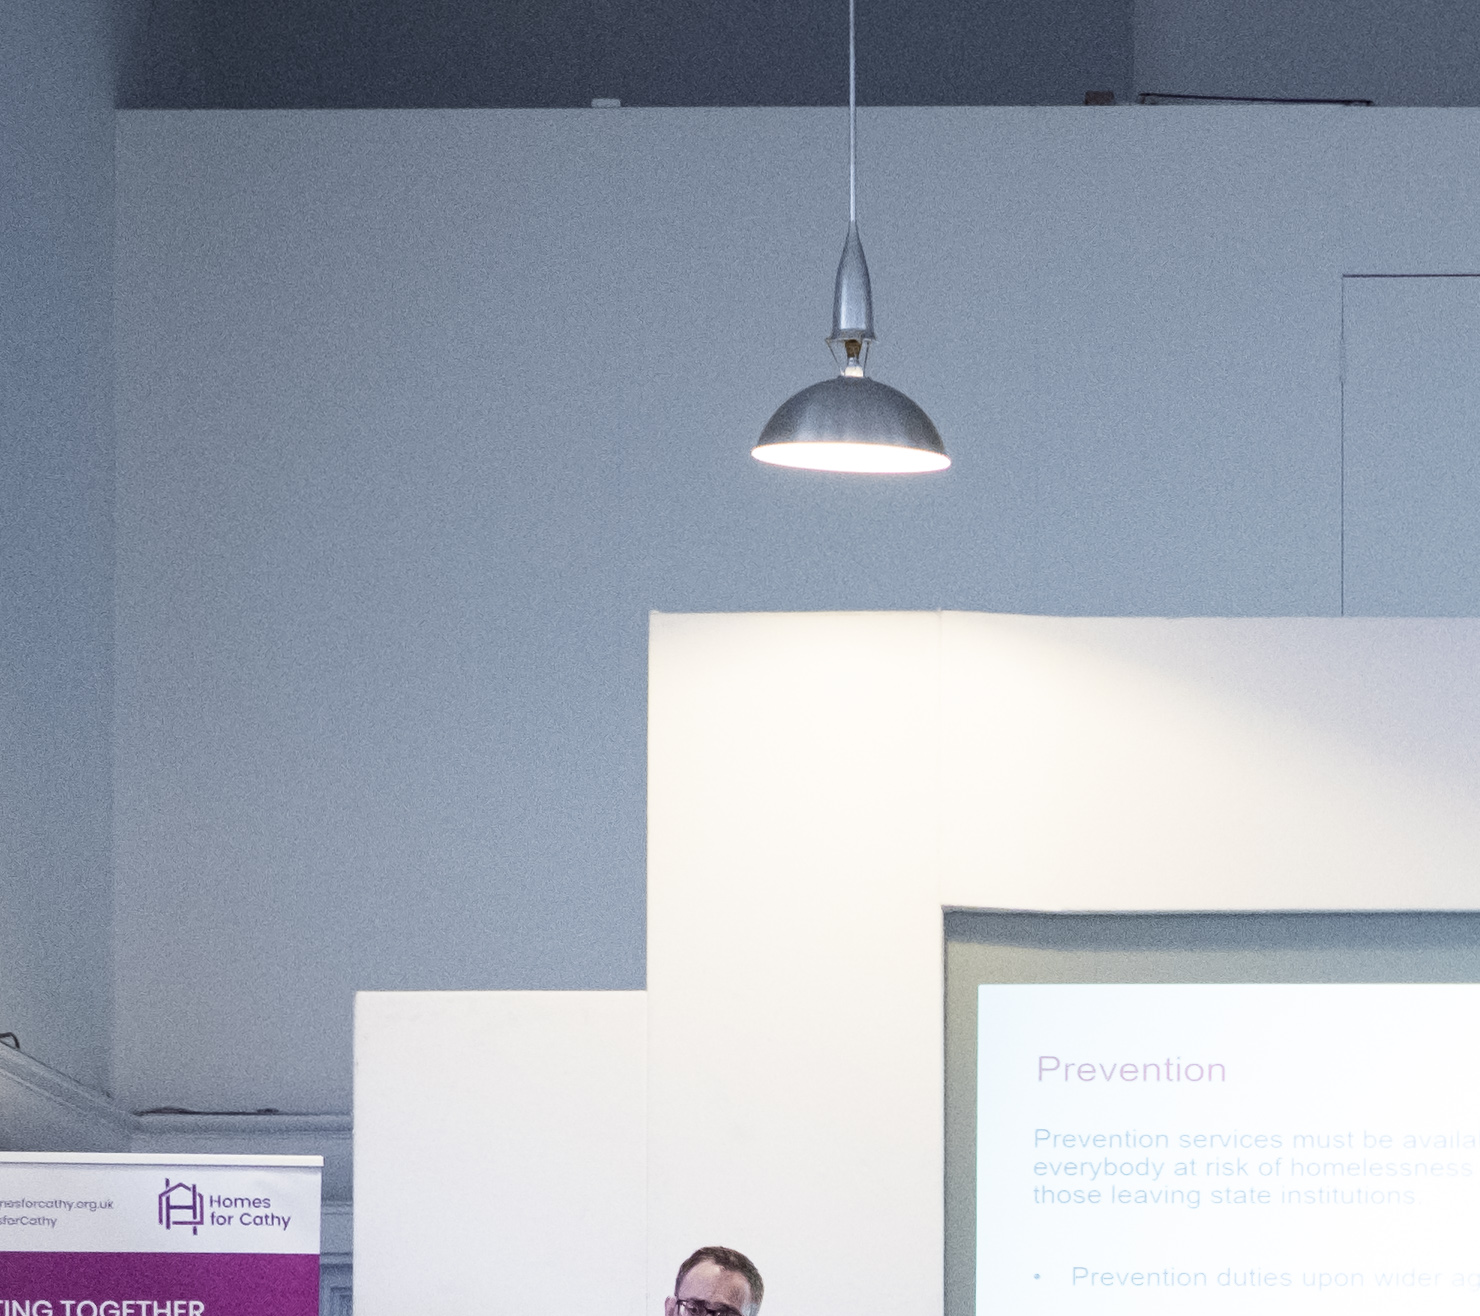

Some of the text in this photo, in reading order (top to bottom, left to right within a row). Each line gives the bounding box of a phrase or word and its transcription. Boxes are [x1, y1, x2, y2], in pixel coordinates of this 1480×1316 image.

[1037, 1056, 1227, 1083] Prevention
[1033, 1128, 1169, 1149] Prevention
[1178, 1130, 1284, 1149] services
[1292, 1132, 1354, 1149] must
[1363, 1130, 1394, 1149] be
[1032, 1157, 1165, 1182] everybody
[1173, 1159, 1197, 1177] at
[1206, 1158, 1249, 1177] risk
[1257, 1157, 1283, 1177] of
[1290, 1158, 1474, 1178] homelessness
[209, 1195, 272, 1209] Homes
[1032, 1185, 1102, 1205] those
[1111, 1186, 1201, 1210] leaving
[1210, 1188, 1272, 1205] state
[210, 1211, 292, 1232] for Cathy
[1071, 1266, 1208, 1288] Prevention
[1216, 1267, 1293, 1288] duties
[1301, 1272, 1365, 1292] upon
[1374, 1268, 1443, 1288] wider
